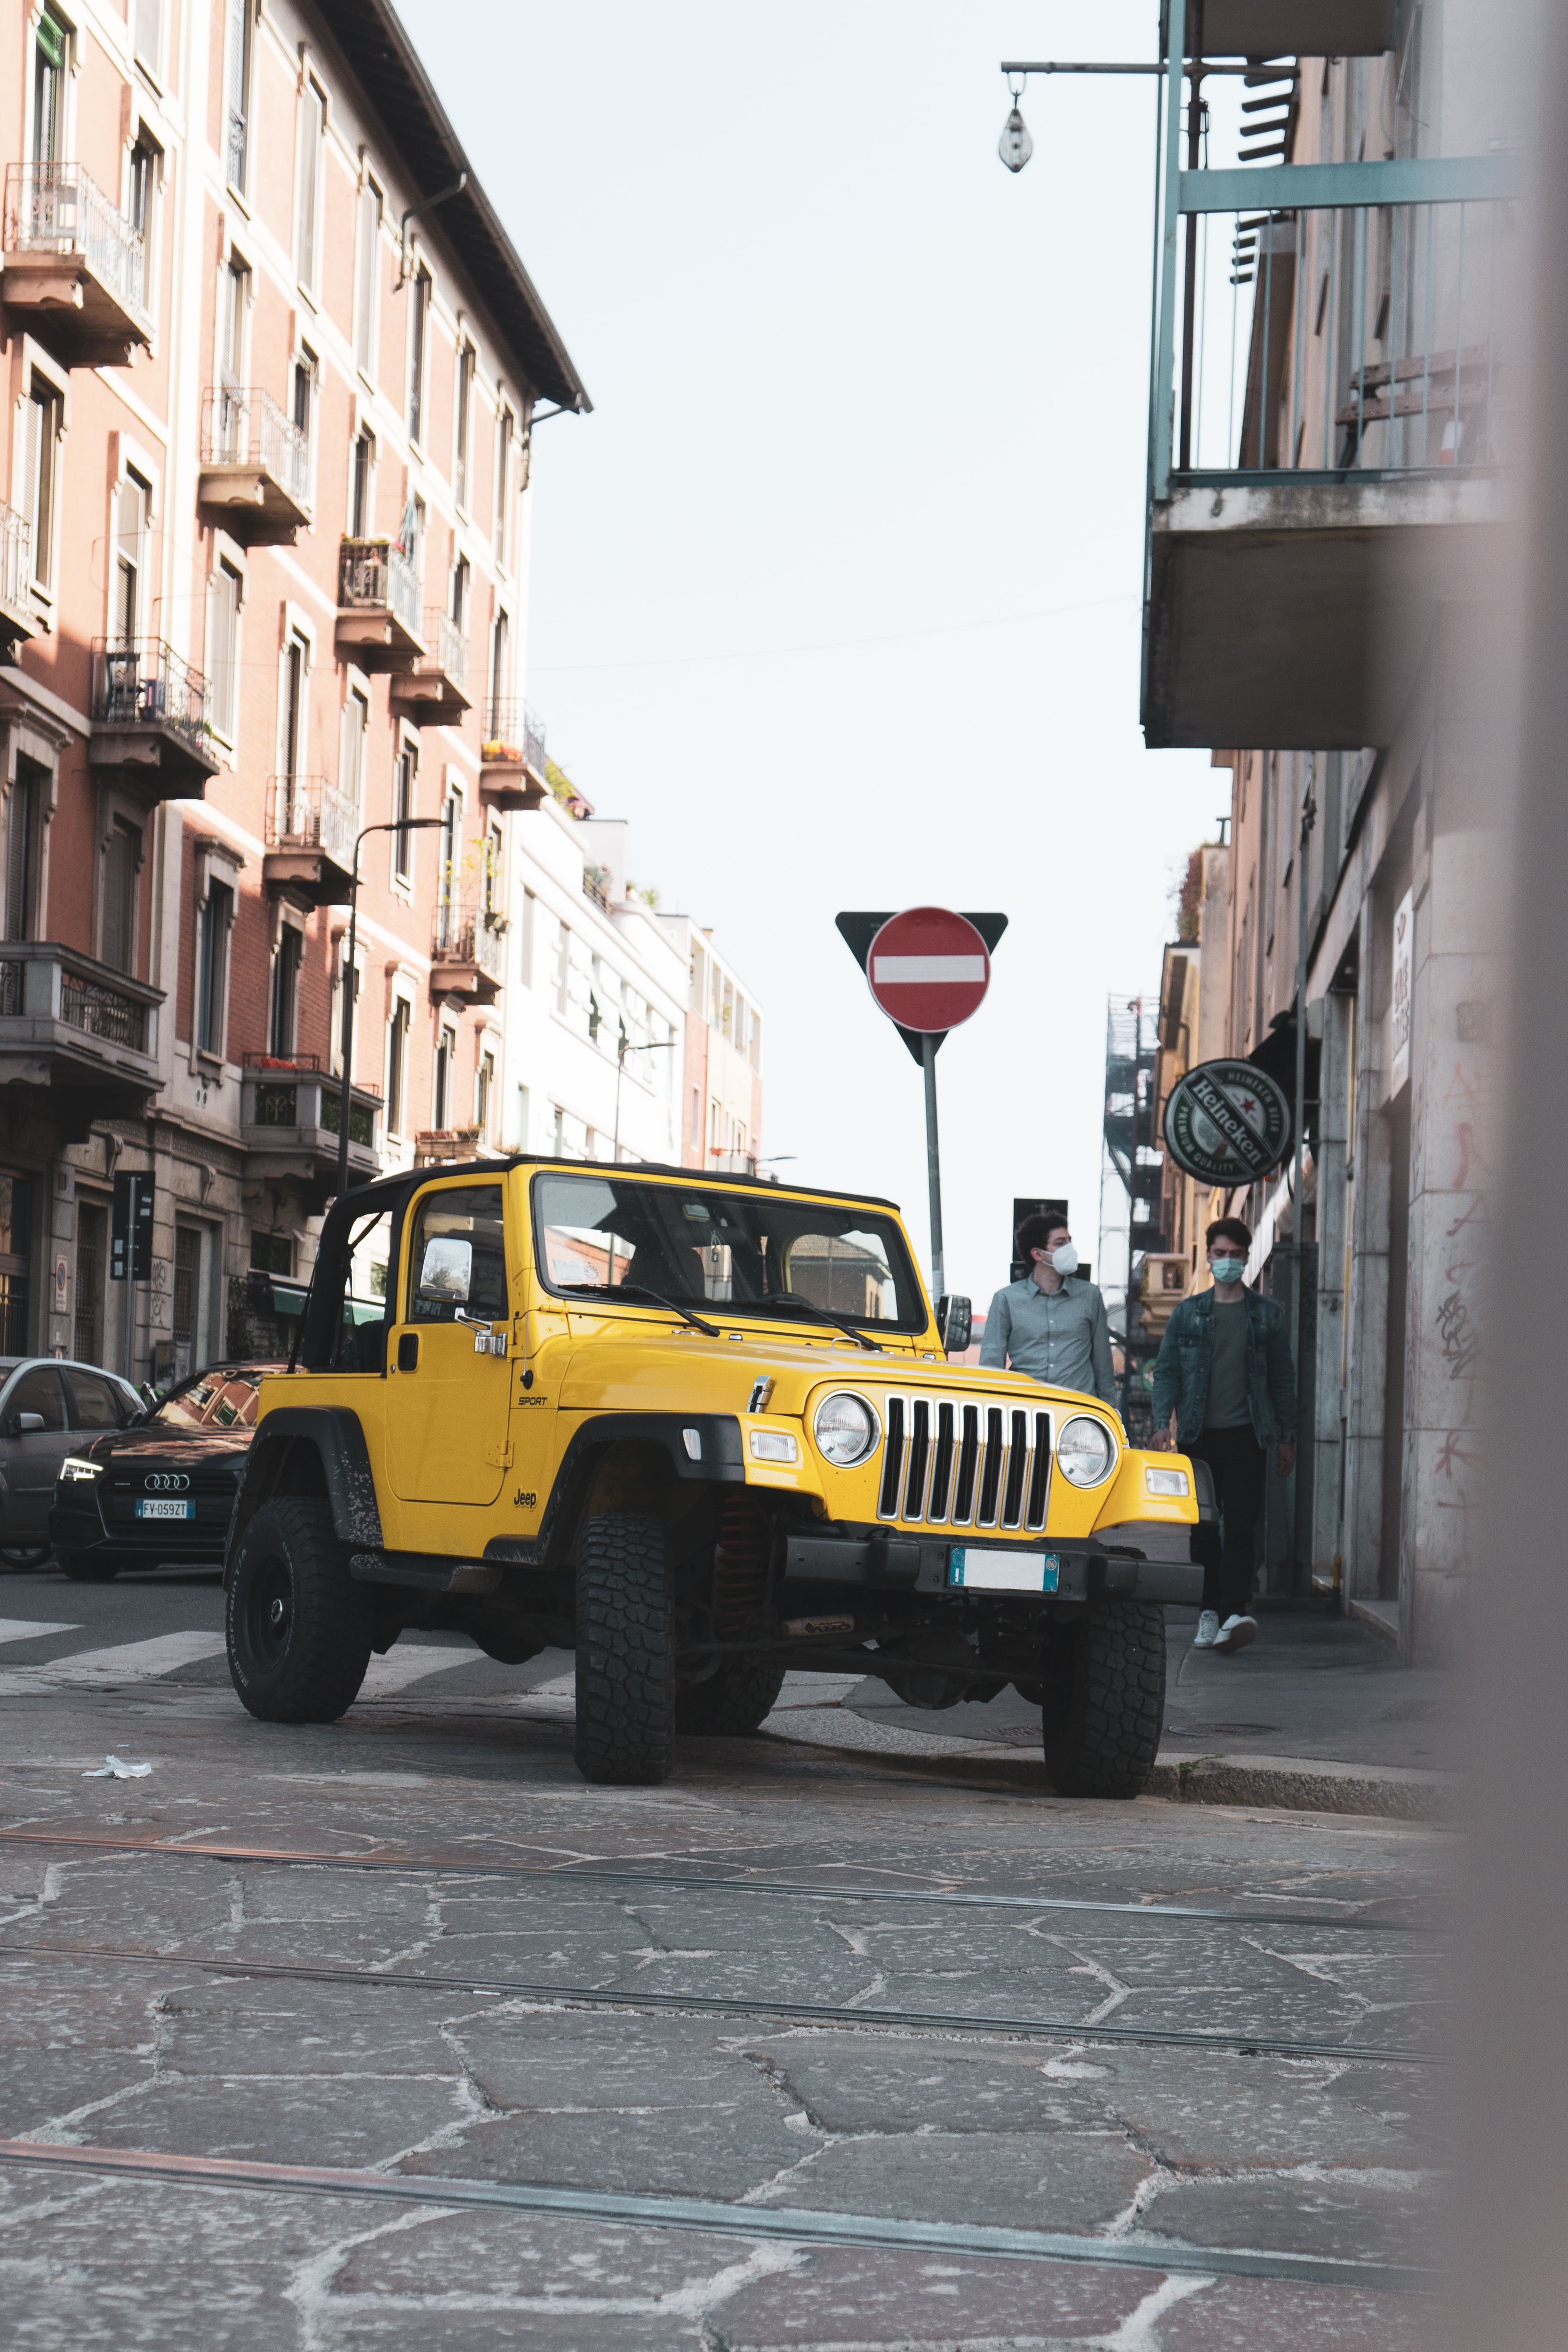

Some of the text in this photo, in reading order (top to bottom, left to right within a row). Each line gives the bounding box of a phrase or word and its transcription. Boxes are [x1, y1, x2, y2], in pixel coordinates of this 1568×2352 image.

[1177, 1106, 1234, 1172] PREMIUM QUALITY
[1192, 1078, 1262, 1164] Heineken
[518, 1397, 547, 1406] SPORT
[513, 1488, 537, 1509] Jeep
